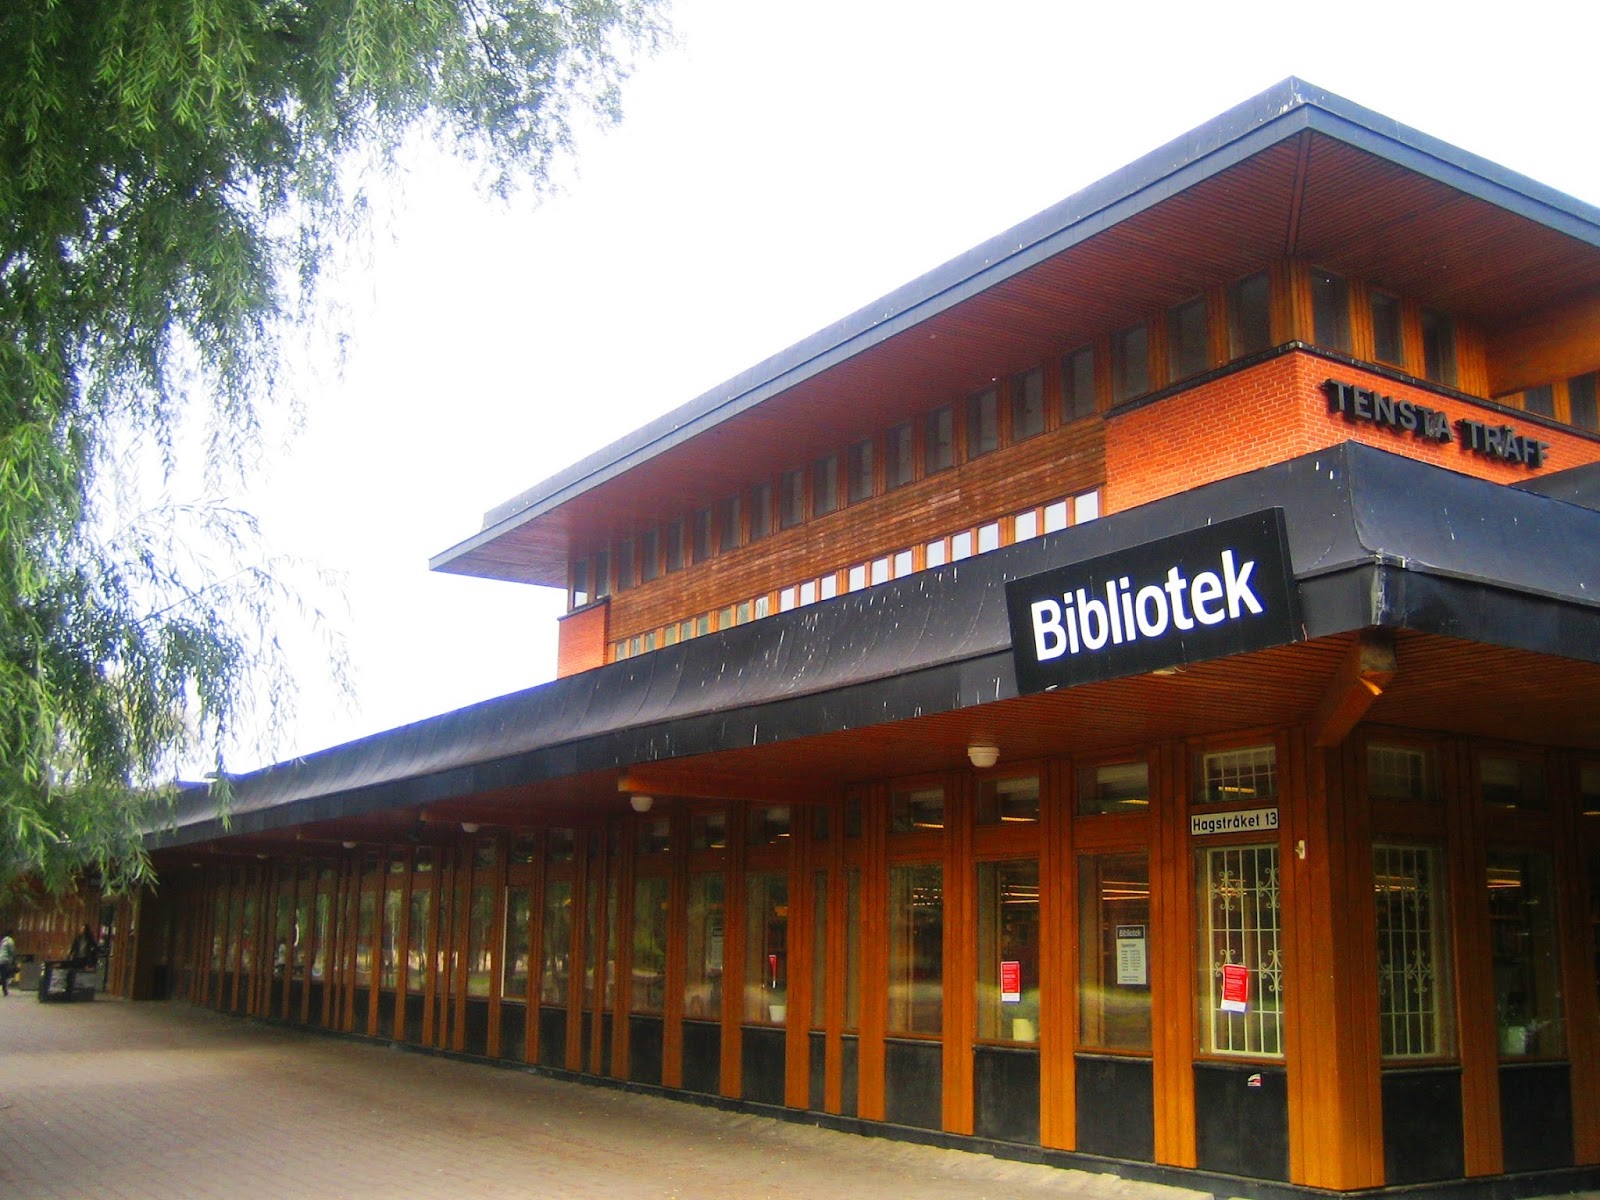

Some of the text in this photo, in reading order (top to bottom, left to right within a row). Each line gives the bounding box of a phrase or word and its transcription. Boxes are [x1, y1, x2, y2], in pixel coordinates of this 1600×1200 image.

[1325, 378, 1454, 444] TENSTA
[1031, 550, 1263, 661] Bibliotek
[1193, 812, 1277, 832] Hagstråket 13
